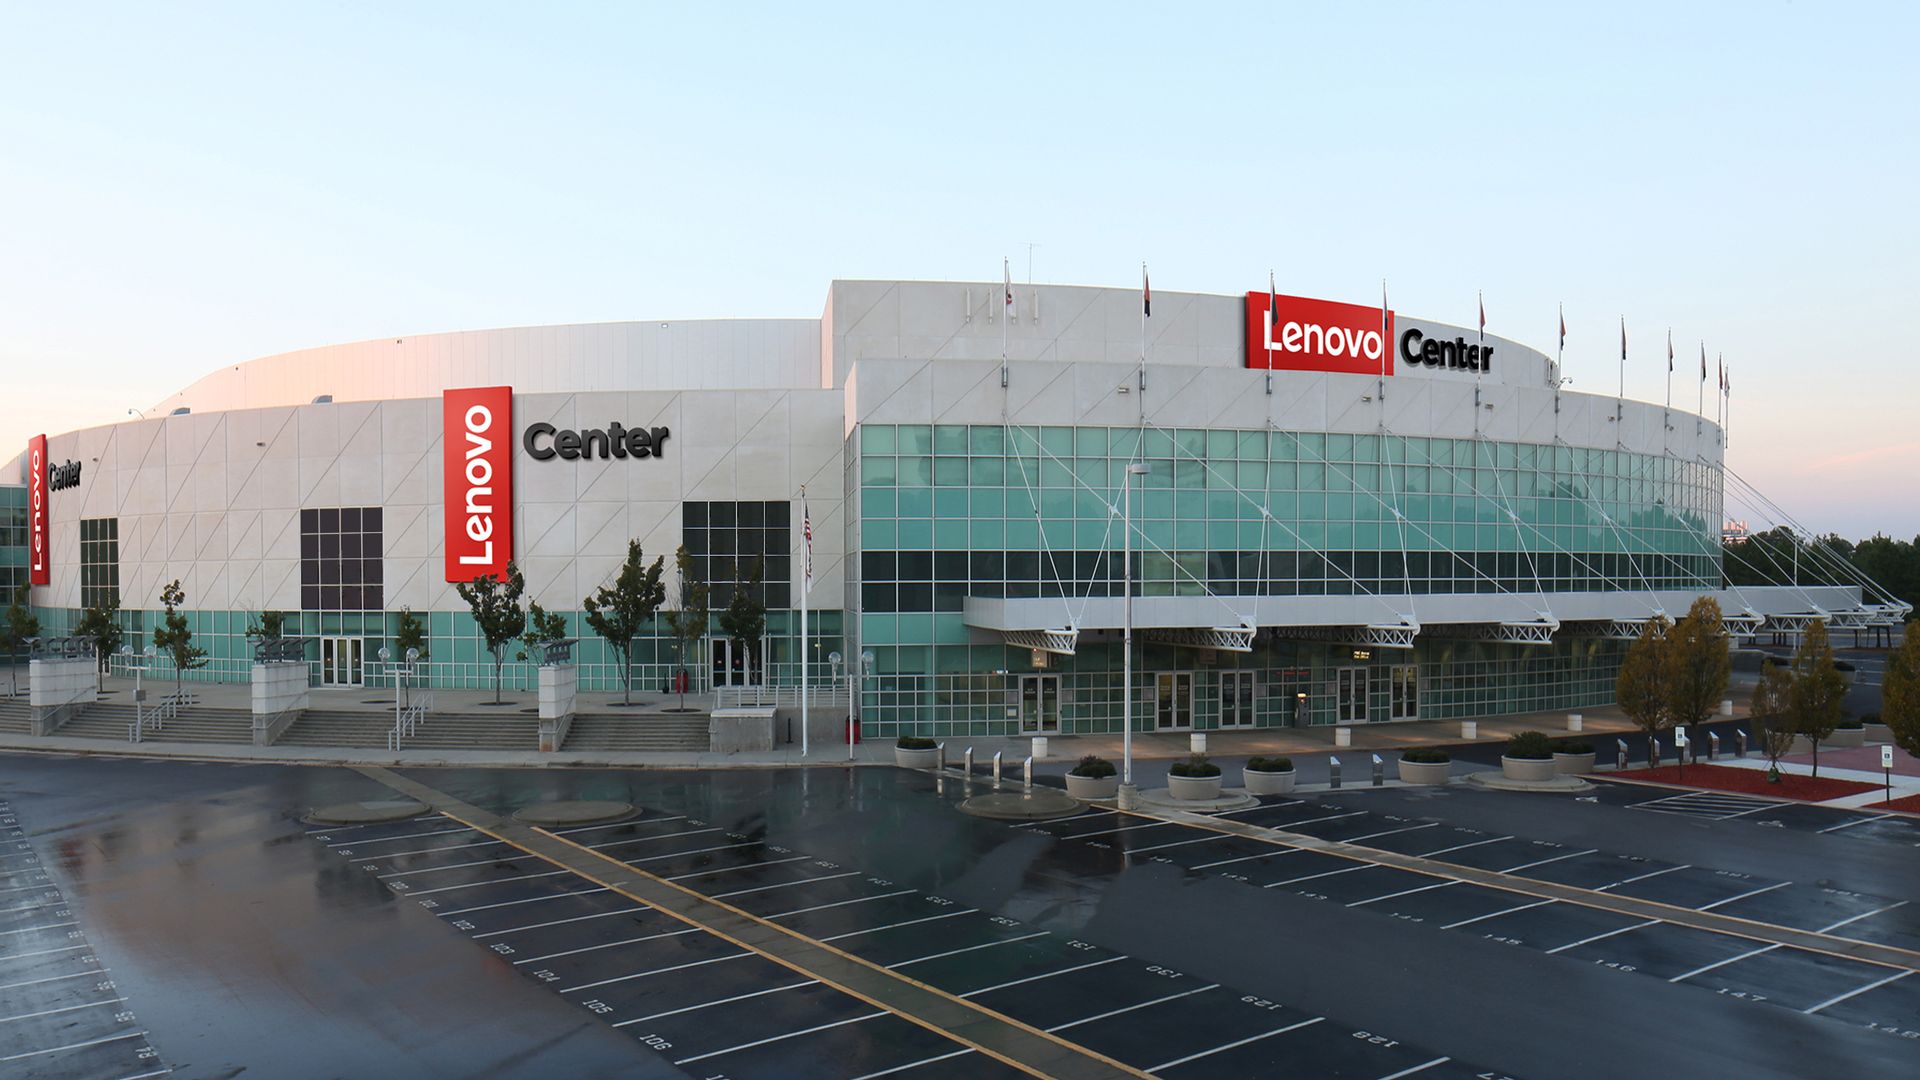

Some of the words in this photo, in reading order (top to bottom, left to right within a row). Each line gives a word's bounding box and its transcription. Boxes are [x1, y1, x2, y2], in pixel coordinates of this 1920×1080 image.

[1263, 309, 1383, 360] Lenovo
[1400, 328, 1494, 374] Center
[523, 421, 669, 460] Center
[49, 459, 82, 492] Center
[459, 404, 493, 565] Lenovo
[33, 449, 43, 572] Lenovo
[1066, 939, 1096, 951] 131
[533, 969, 561, 982] 104
[1146, 965, 1183, 978] 130
[582, 999, 614, 1014] 105
[1241, 995, 1282, 1010] 129
[639, 1034, 673, 1050] 106
[1352, 1031, 1399, 1048] 128
